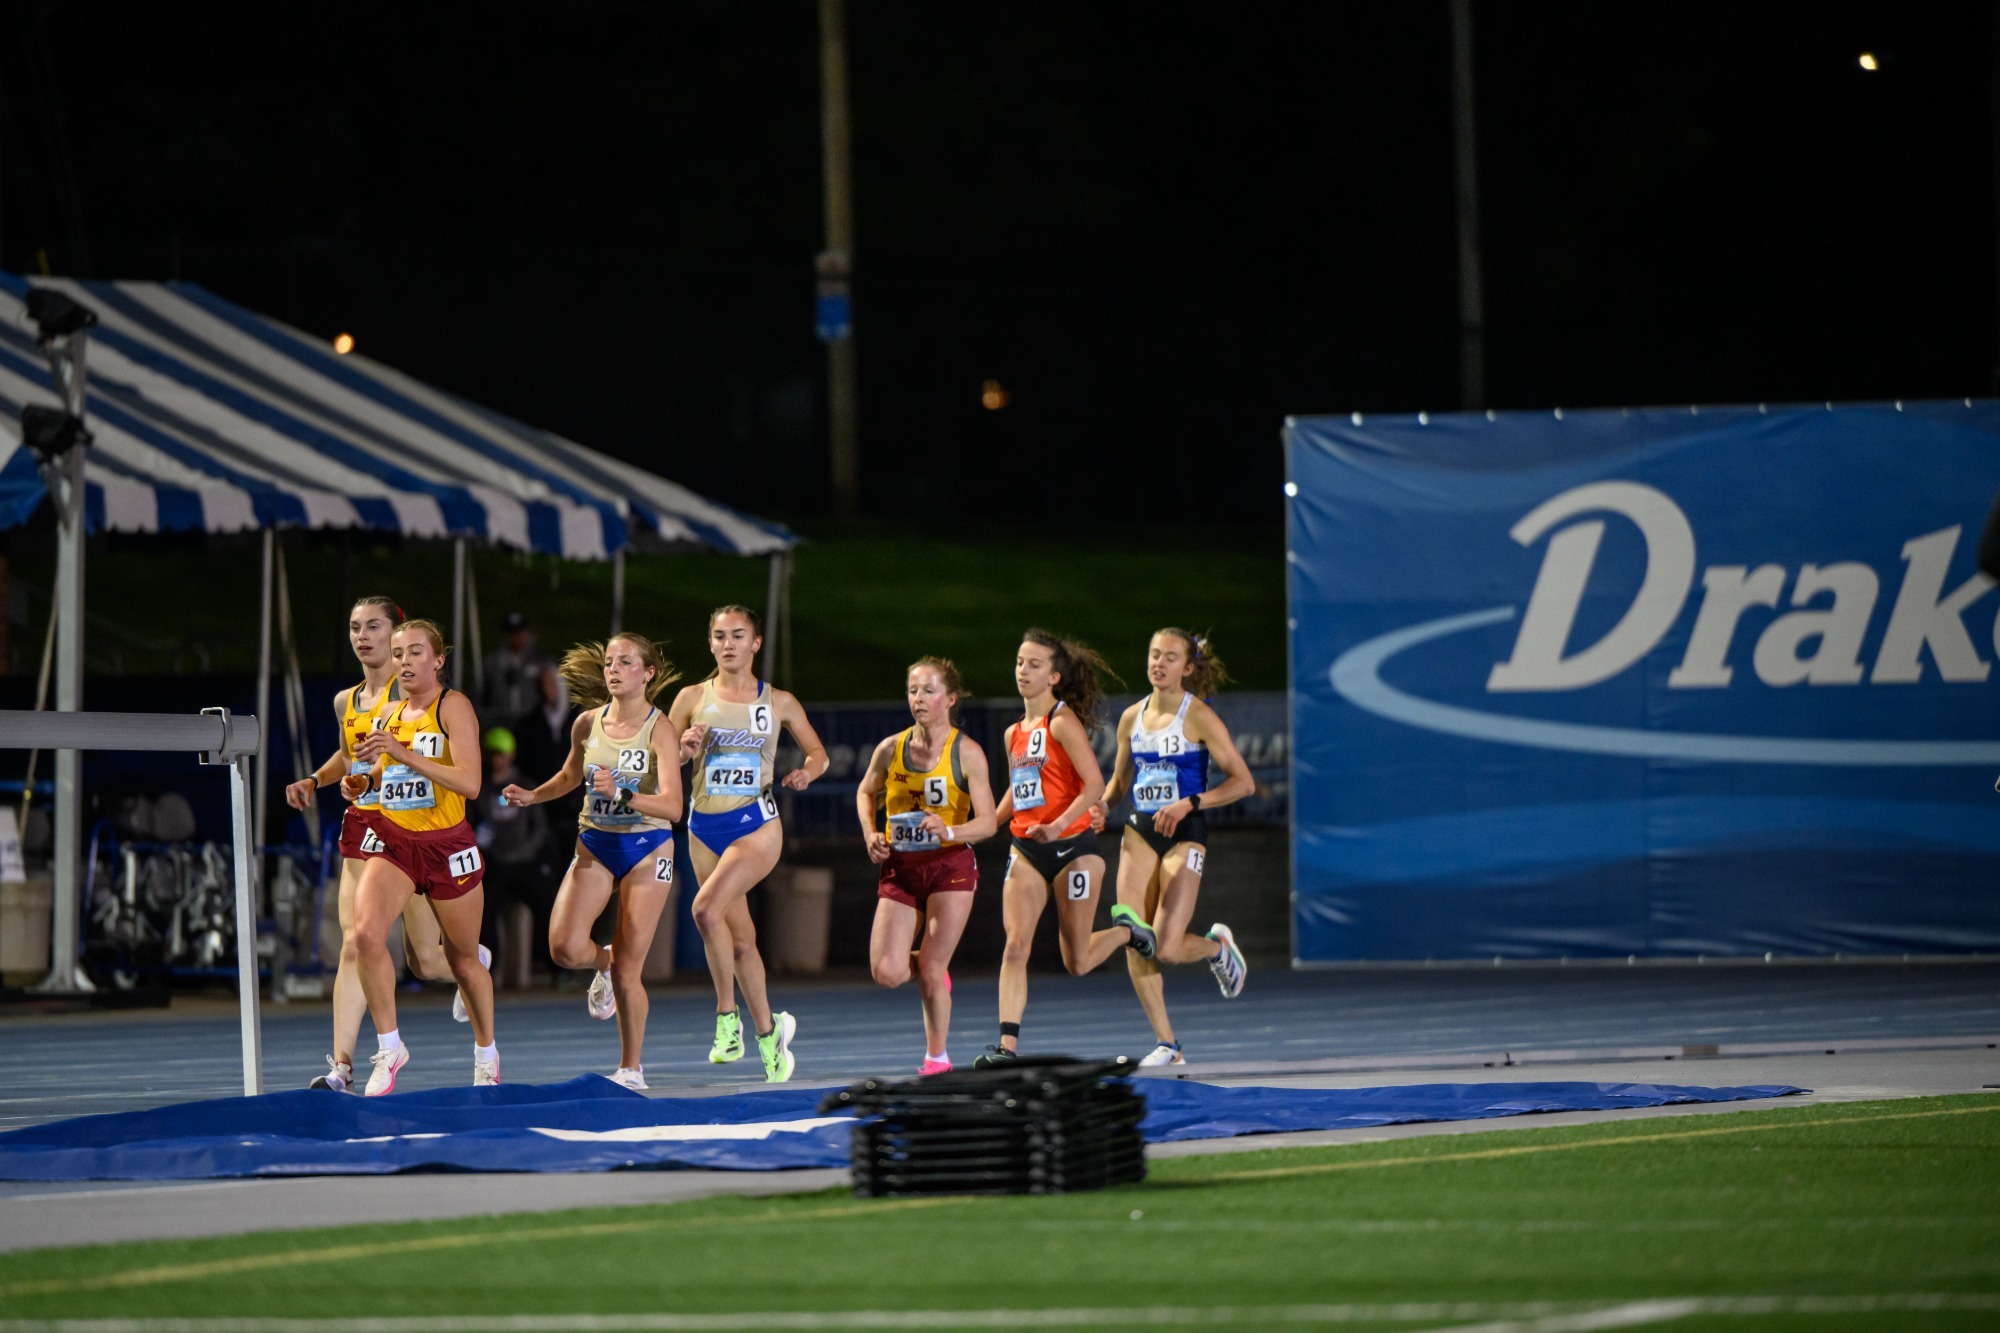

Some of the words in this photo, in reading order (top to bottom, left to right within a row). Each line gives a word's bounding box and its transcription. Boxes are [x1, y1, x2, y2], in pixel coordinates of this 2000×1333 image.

[1487, 480, 2000, 692] Drak
[755, 706, 769, 732] 6
[419, 735, 437, 756] 11
[706, 726, 767, 748] Tulsa
[1031, 730, 1042, 755] 9
[1163, 735, 1180, 754] 13
[620, 749, 646, 772] 23
[711, 769, 754, 786] 4725
[384, 780, 427, 800] 3478
[930, 778, 944, 805] 5
[1137, 785, 1173, 801] 3073
[762, 789, 776, 815] 6
[456, 851, 476, 873] 11
[656, 858, 673, 881] 23
[1073, 872, 1086, 898] 9
